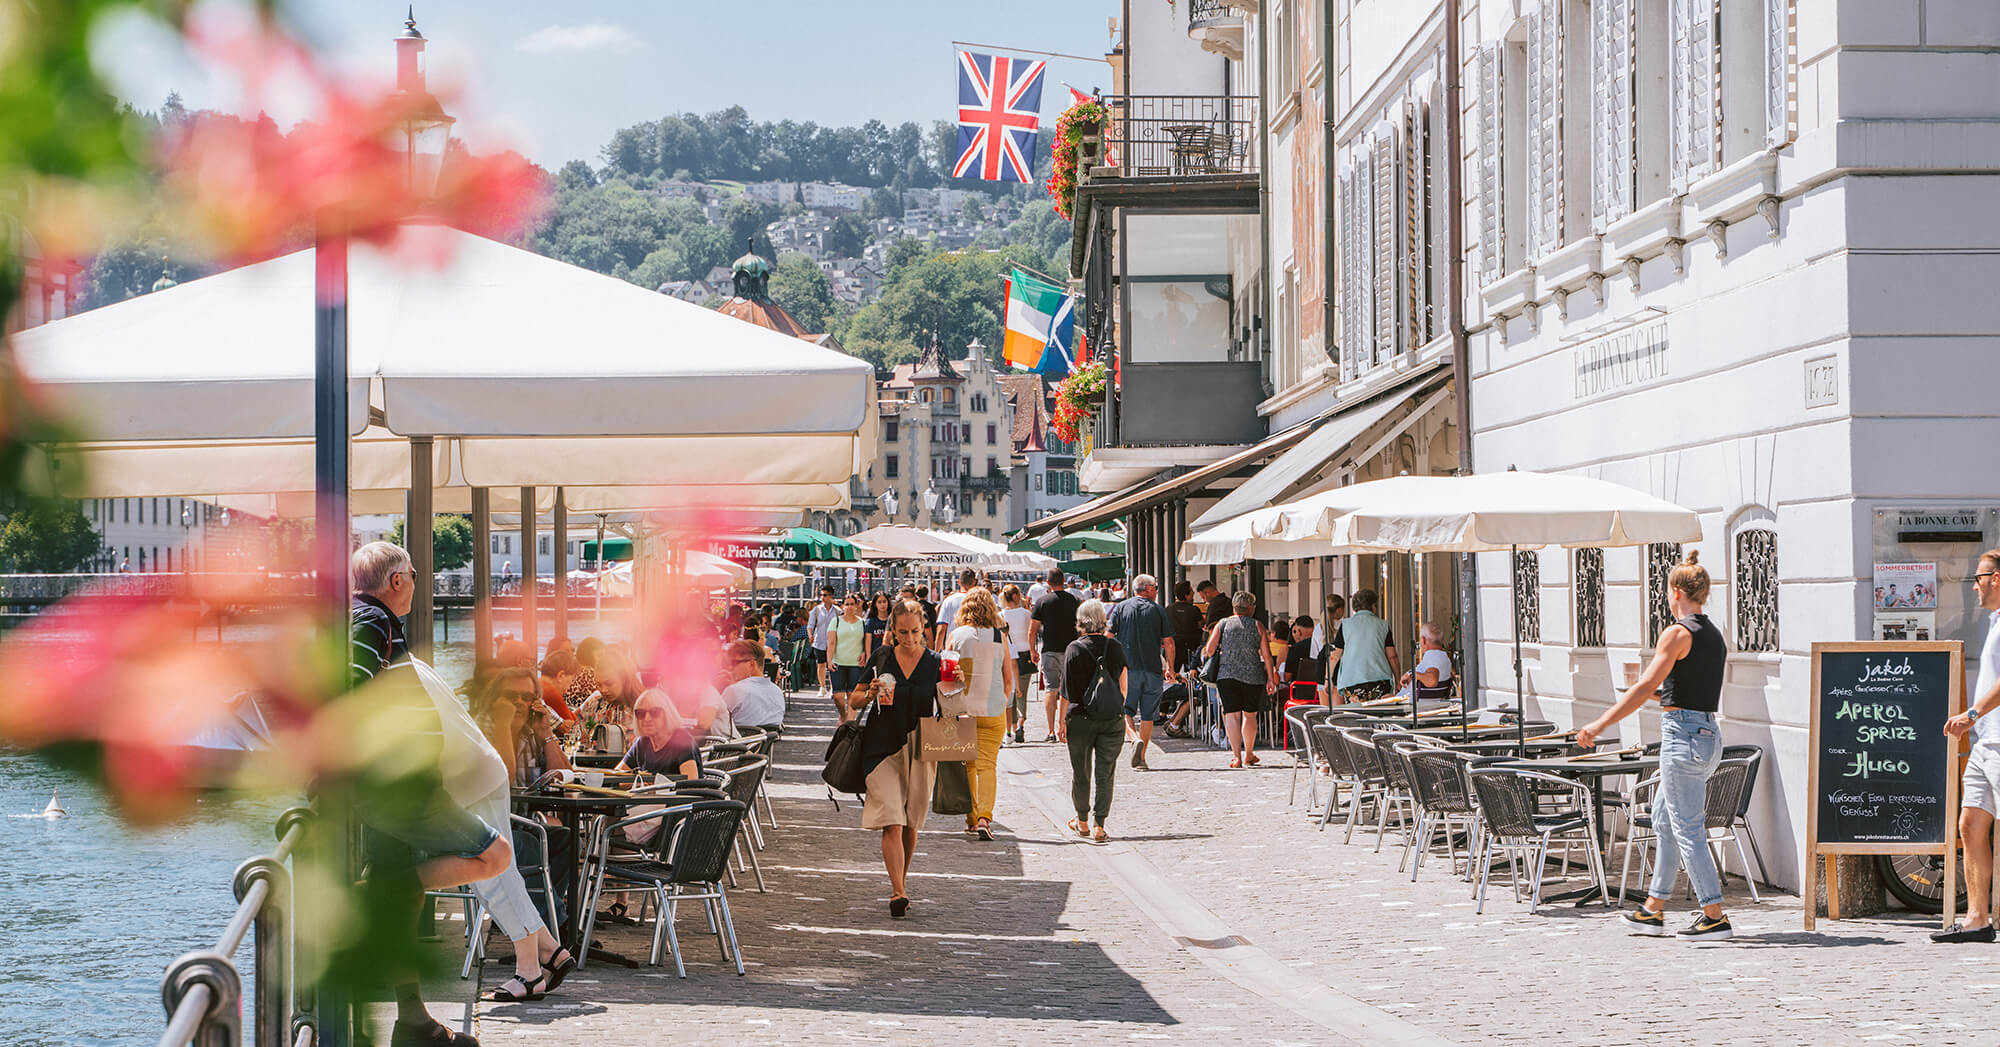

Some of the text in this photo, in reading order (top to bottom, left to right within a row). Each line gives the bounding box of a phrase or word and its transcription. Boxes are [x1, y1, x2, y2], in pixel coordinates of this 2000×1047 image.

[1574, 322, 1669, 399] LA BONNE CAVE
[1899, 516, 1978, 526] LA BONNE CAVE
[727, 544, 777, 560] Pickwick
[1835, 700, 1910, 723] APEROL
[1842, 750, 1910, 779] HUGO
